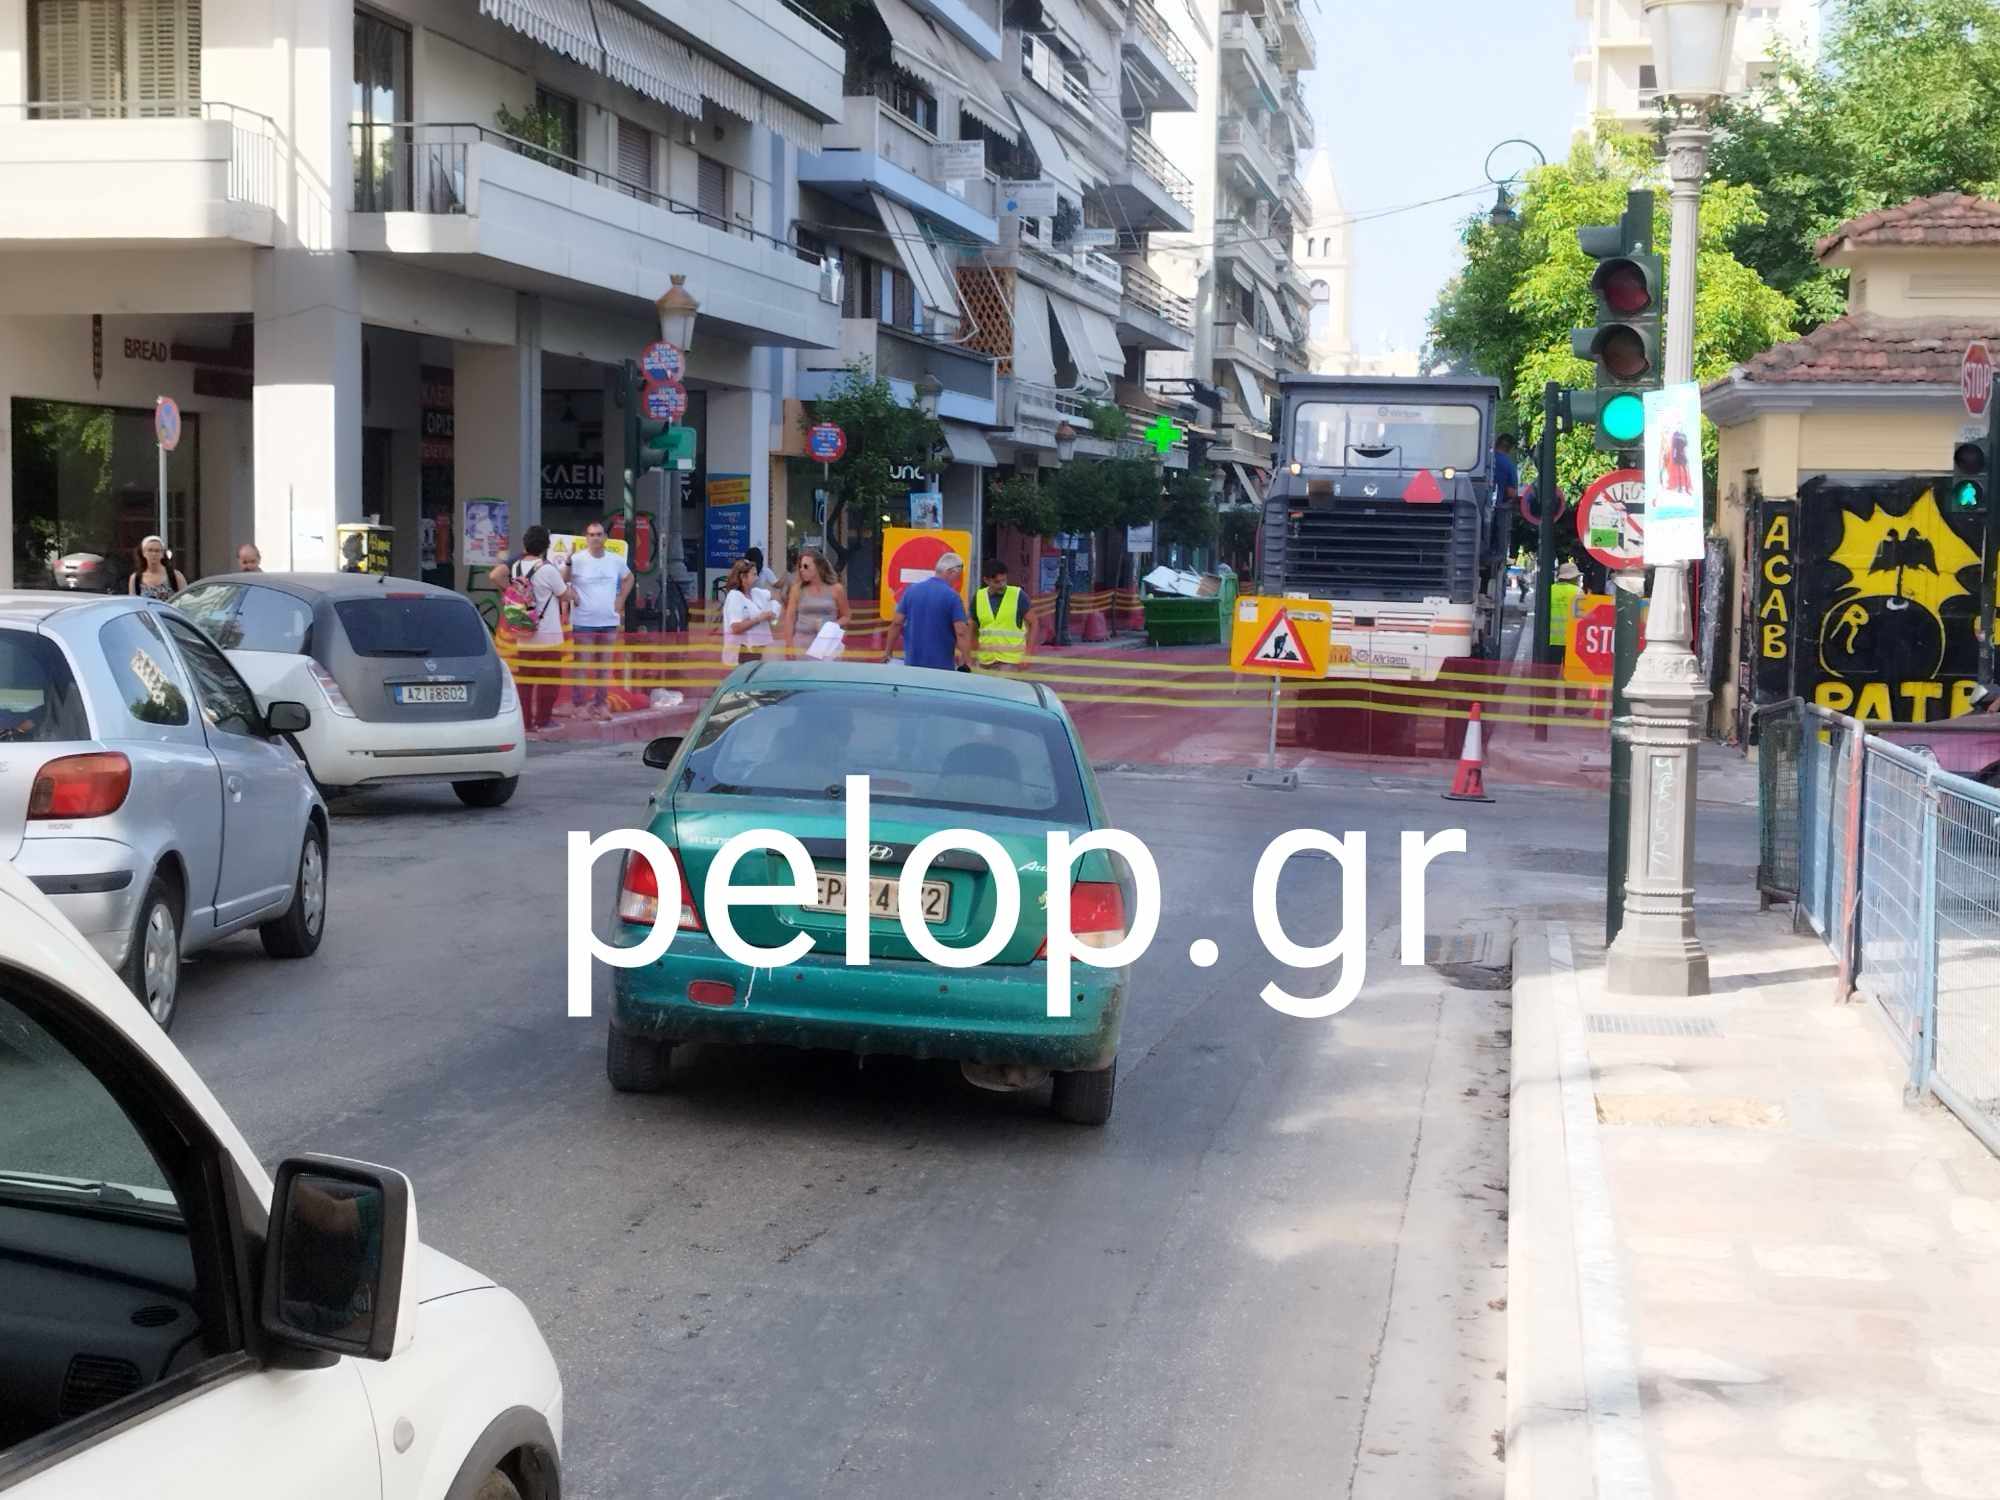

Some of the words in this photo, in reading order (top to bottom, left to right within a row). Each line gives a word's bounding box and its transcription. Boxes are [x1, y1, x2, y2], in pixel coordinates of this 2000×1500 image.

[123, 337, 167, 362] BREAD
[1964, 361, 1990, 399] STOP
[541, 488, 584, 500] ΕΛΟΣ
[1760, 515, 1792, 659] ACAB
[875, 882, 942, 916] 42
